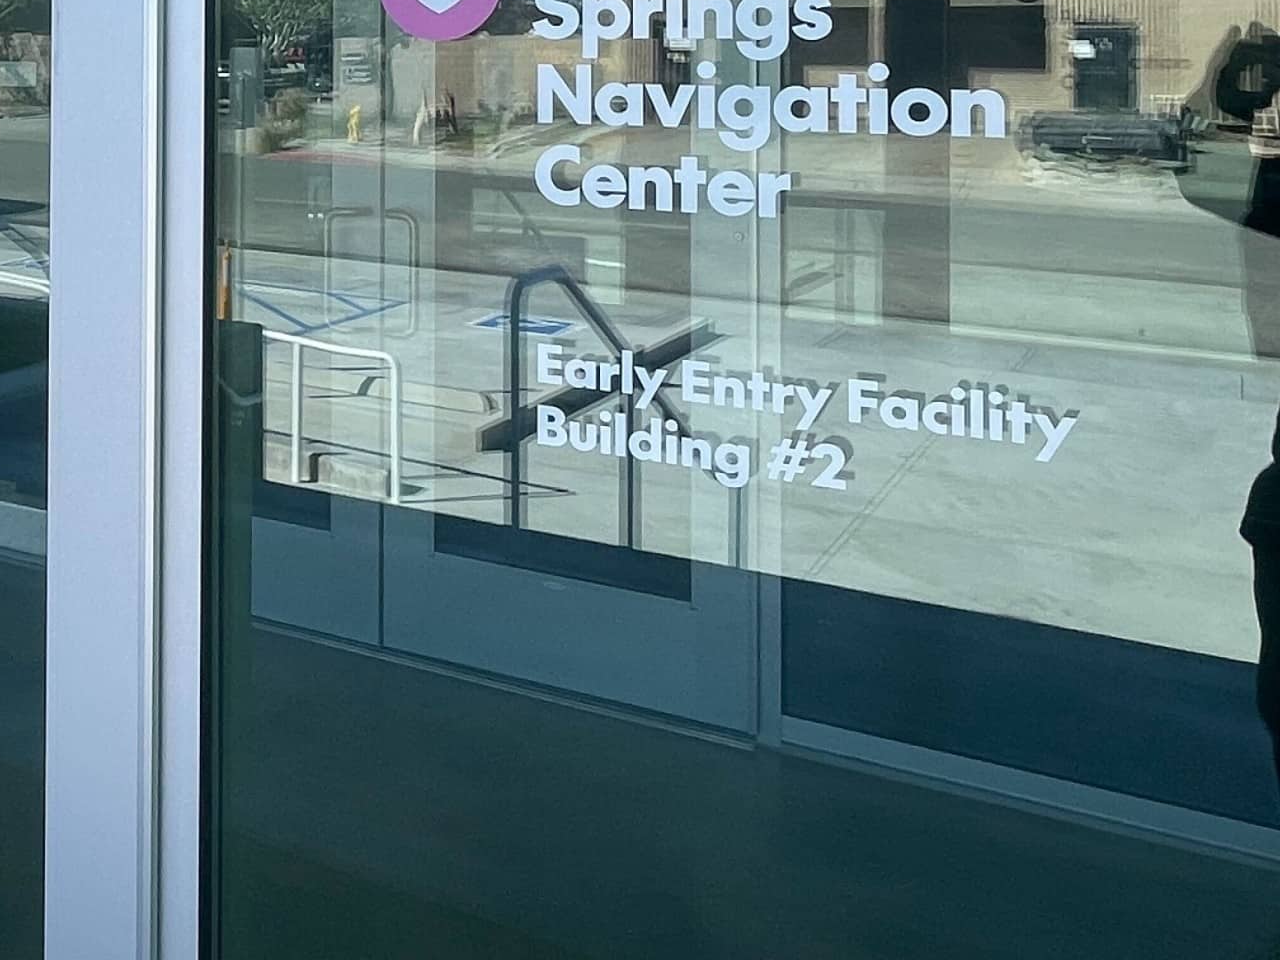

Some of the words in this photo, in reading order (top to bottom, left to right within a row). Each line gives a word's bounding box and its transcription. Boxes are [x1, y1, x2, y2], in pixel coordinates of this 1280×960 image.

[537, 61, 1006, 153] Navigation
[534, 144, 791, 219] Center
[536, 342, 668, 410] Early
[681, 359, 832, 431] Entry
[847, 378, 1079, 464] Facility
[536, 404, 750, 489] Building
[767, 438, 848, 492] #2
